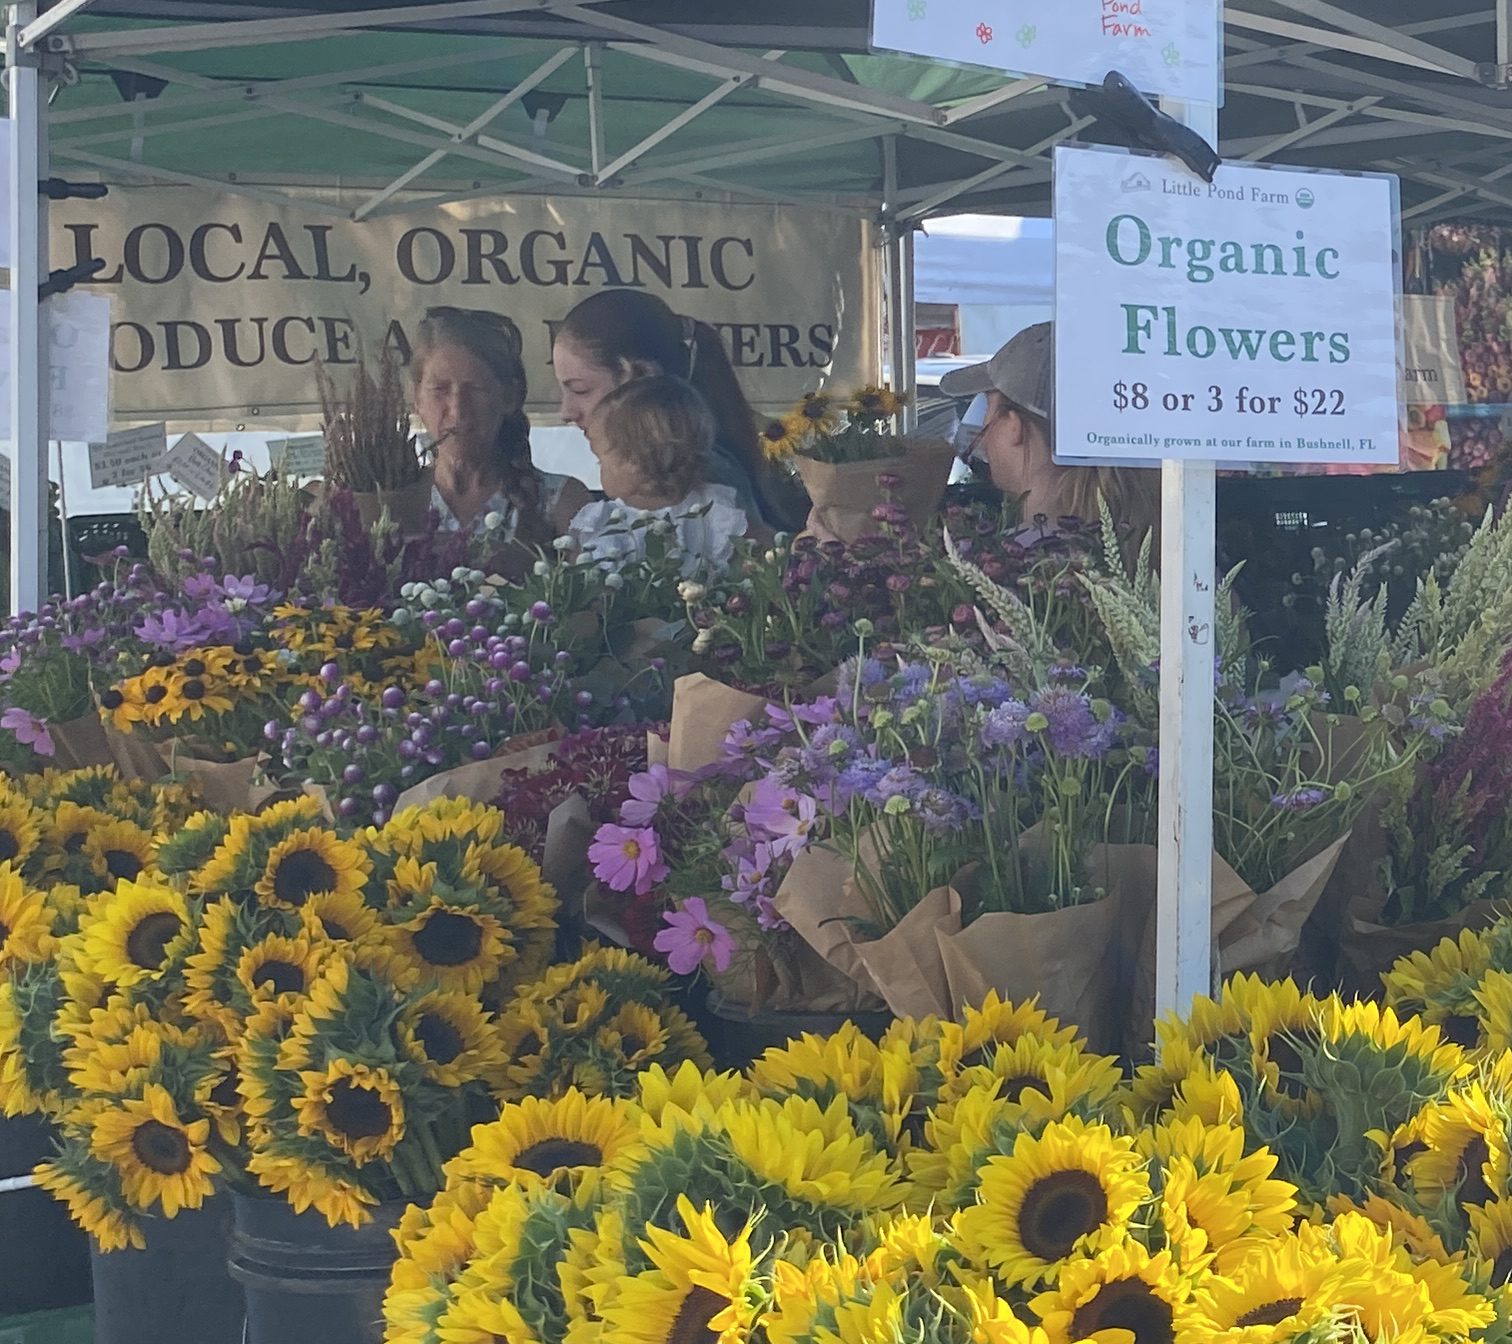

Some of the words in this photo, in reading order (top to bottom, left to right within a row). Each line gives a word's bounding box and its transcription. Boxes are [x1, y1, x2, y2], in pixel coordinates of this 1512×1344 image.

[1101, 14, 1152, 38] Farm
[1162, 178, 1201, 197] Little
[1207, 182, 1245, 201] Pond
[1251, 187, 1290, 204] Farm
[63, 222, 371, 295] LOCAL,
[396, 226, 756, 291] ORGANIC
[1106, 213, 1341, 284] Organic
[1120, 303, 1352, 365] Flowers
[1405, 367, 1439, 383] arm
[1112, 379, 1150, 412] $8
[1162, 390, 1195, 412] or
[1207, 385, 1224, 413] 3
[1236, 386, 1282, 415] for
[1294, 385, 1346, 417] $22
[1086, 431, 1160, 447] Organically
[1163, 435, 1202, 449] grown
[1206, 436, 1218, 447] at
[1221, 437, 1242, 448] our
[1246, 436, 1276, 448] farm
[1279, 436, 1292, 448] in
[1296, 436, 1356, 451] Bushnell,
[1359, 438, 1377, 450] FL
